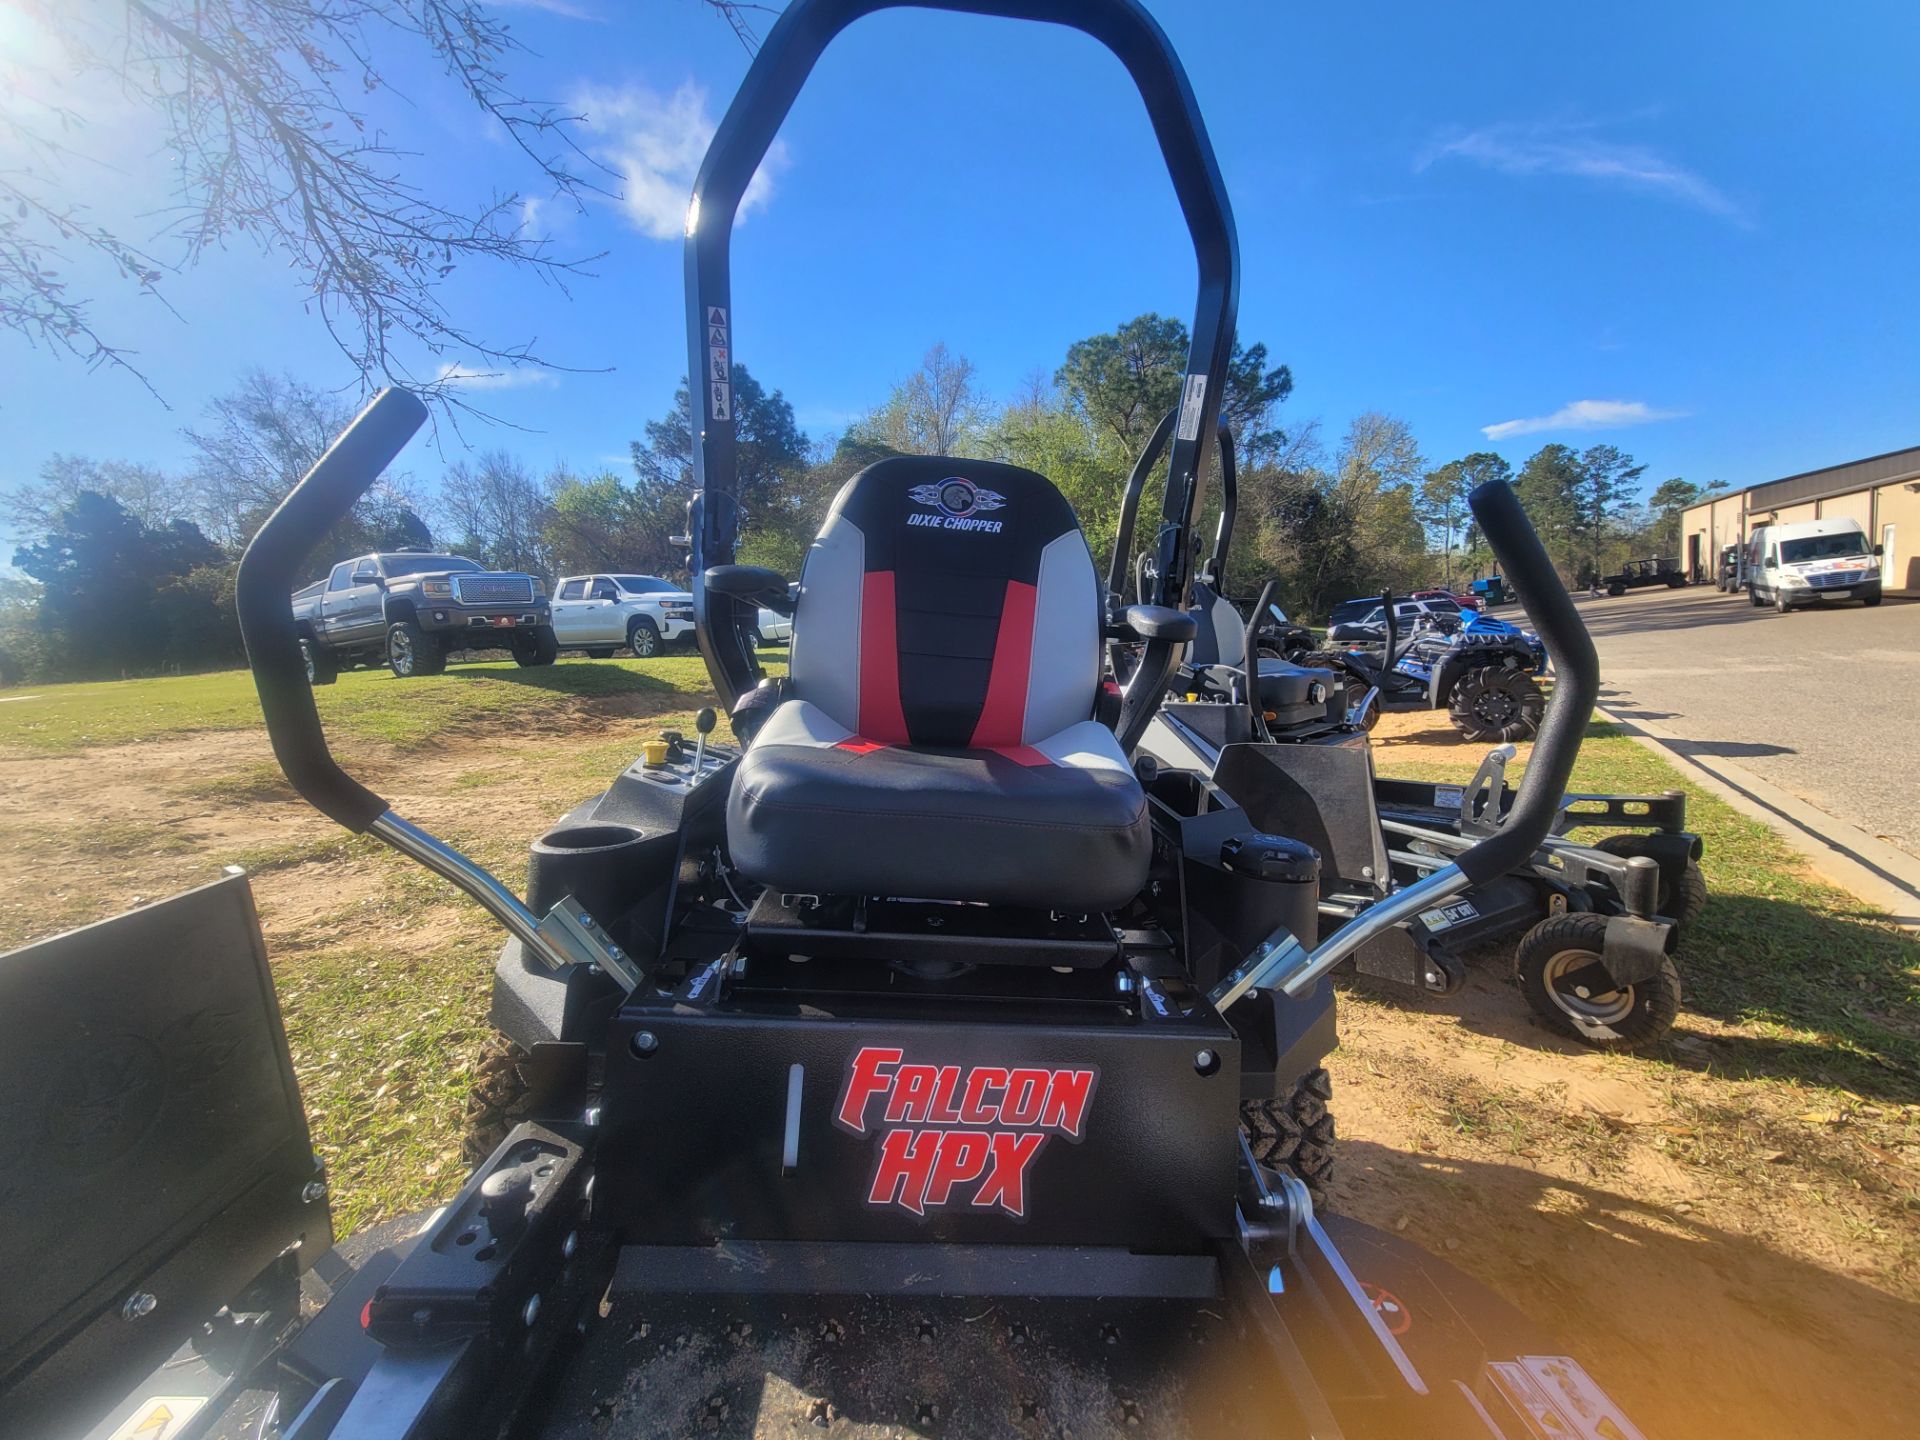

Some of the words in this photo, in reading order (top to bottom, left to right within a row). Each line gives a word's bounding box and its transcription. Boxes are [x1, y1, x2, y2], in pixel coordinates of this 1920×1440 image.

[907, 513, 943, 528] DIXIE
[944, 517, 1002, 533] CHOPPER
[839, 1047, 1094, 1136] FALCON
[868, 1129, 1044, 1216] HPX
